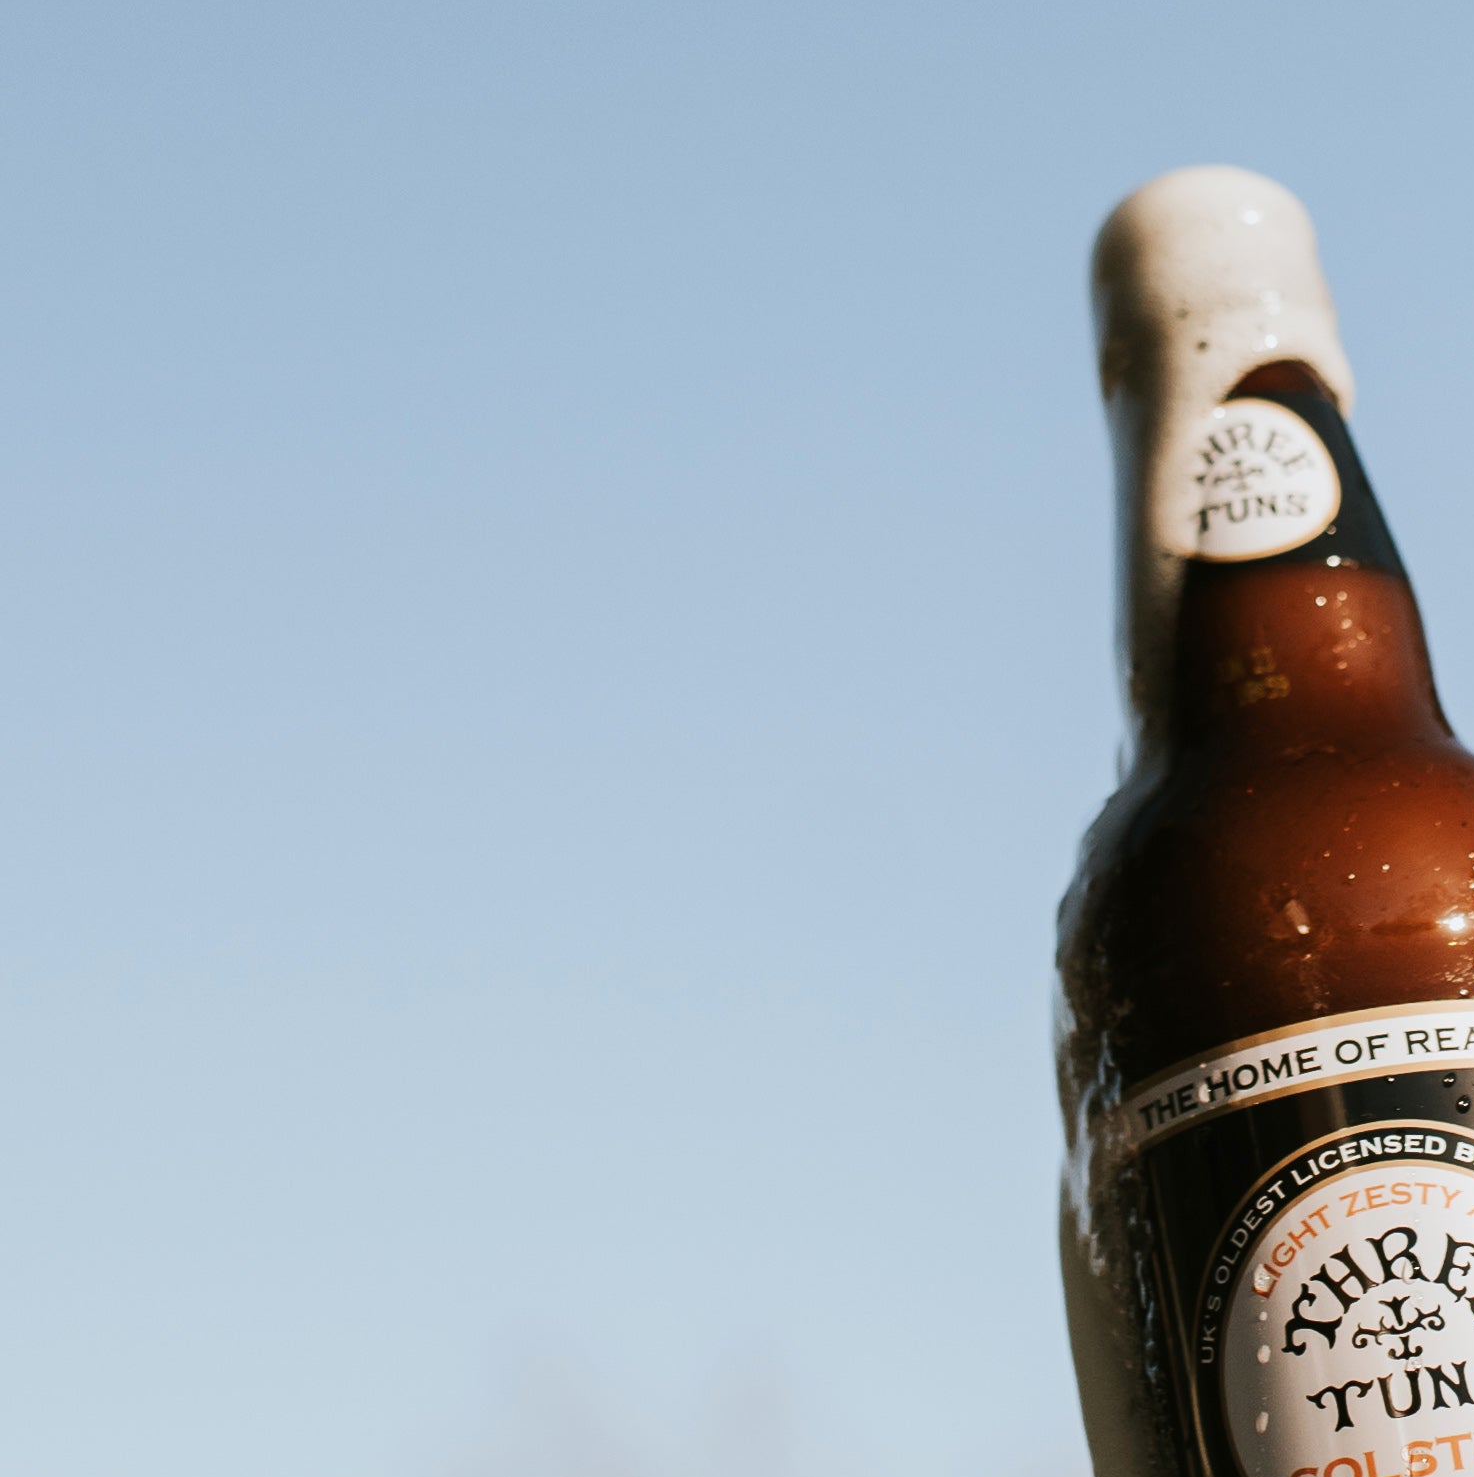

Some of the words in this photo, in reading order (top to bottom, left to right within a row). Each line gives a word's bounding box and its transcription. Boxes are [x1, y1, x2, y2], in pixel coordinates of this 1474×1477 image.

[1195, 422, 1314, 485] HREE
[1138, 1083, 1197, 1130] THE
[1205, 1046, 1321, 1103] HOME
[1334, 1033, 1389, 1064] OF
[1201, 1295, 1221, 1363] UK'S
[1214, 1181, 1285, 1284] OLDEST
[1291, 1134, 1447, 1186] LICENSED
[1253, 1204, 1331, 1298] LIGHT
[1339, 1182, 1462, 1218] ZESTY
